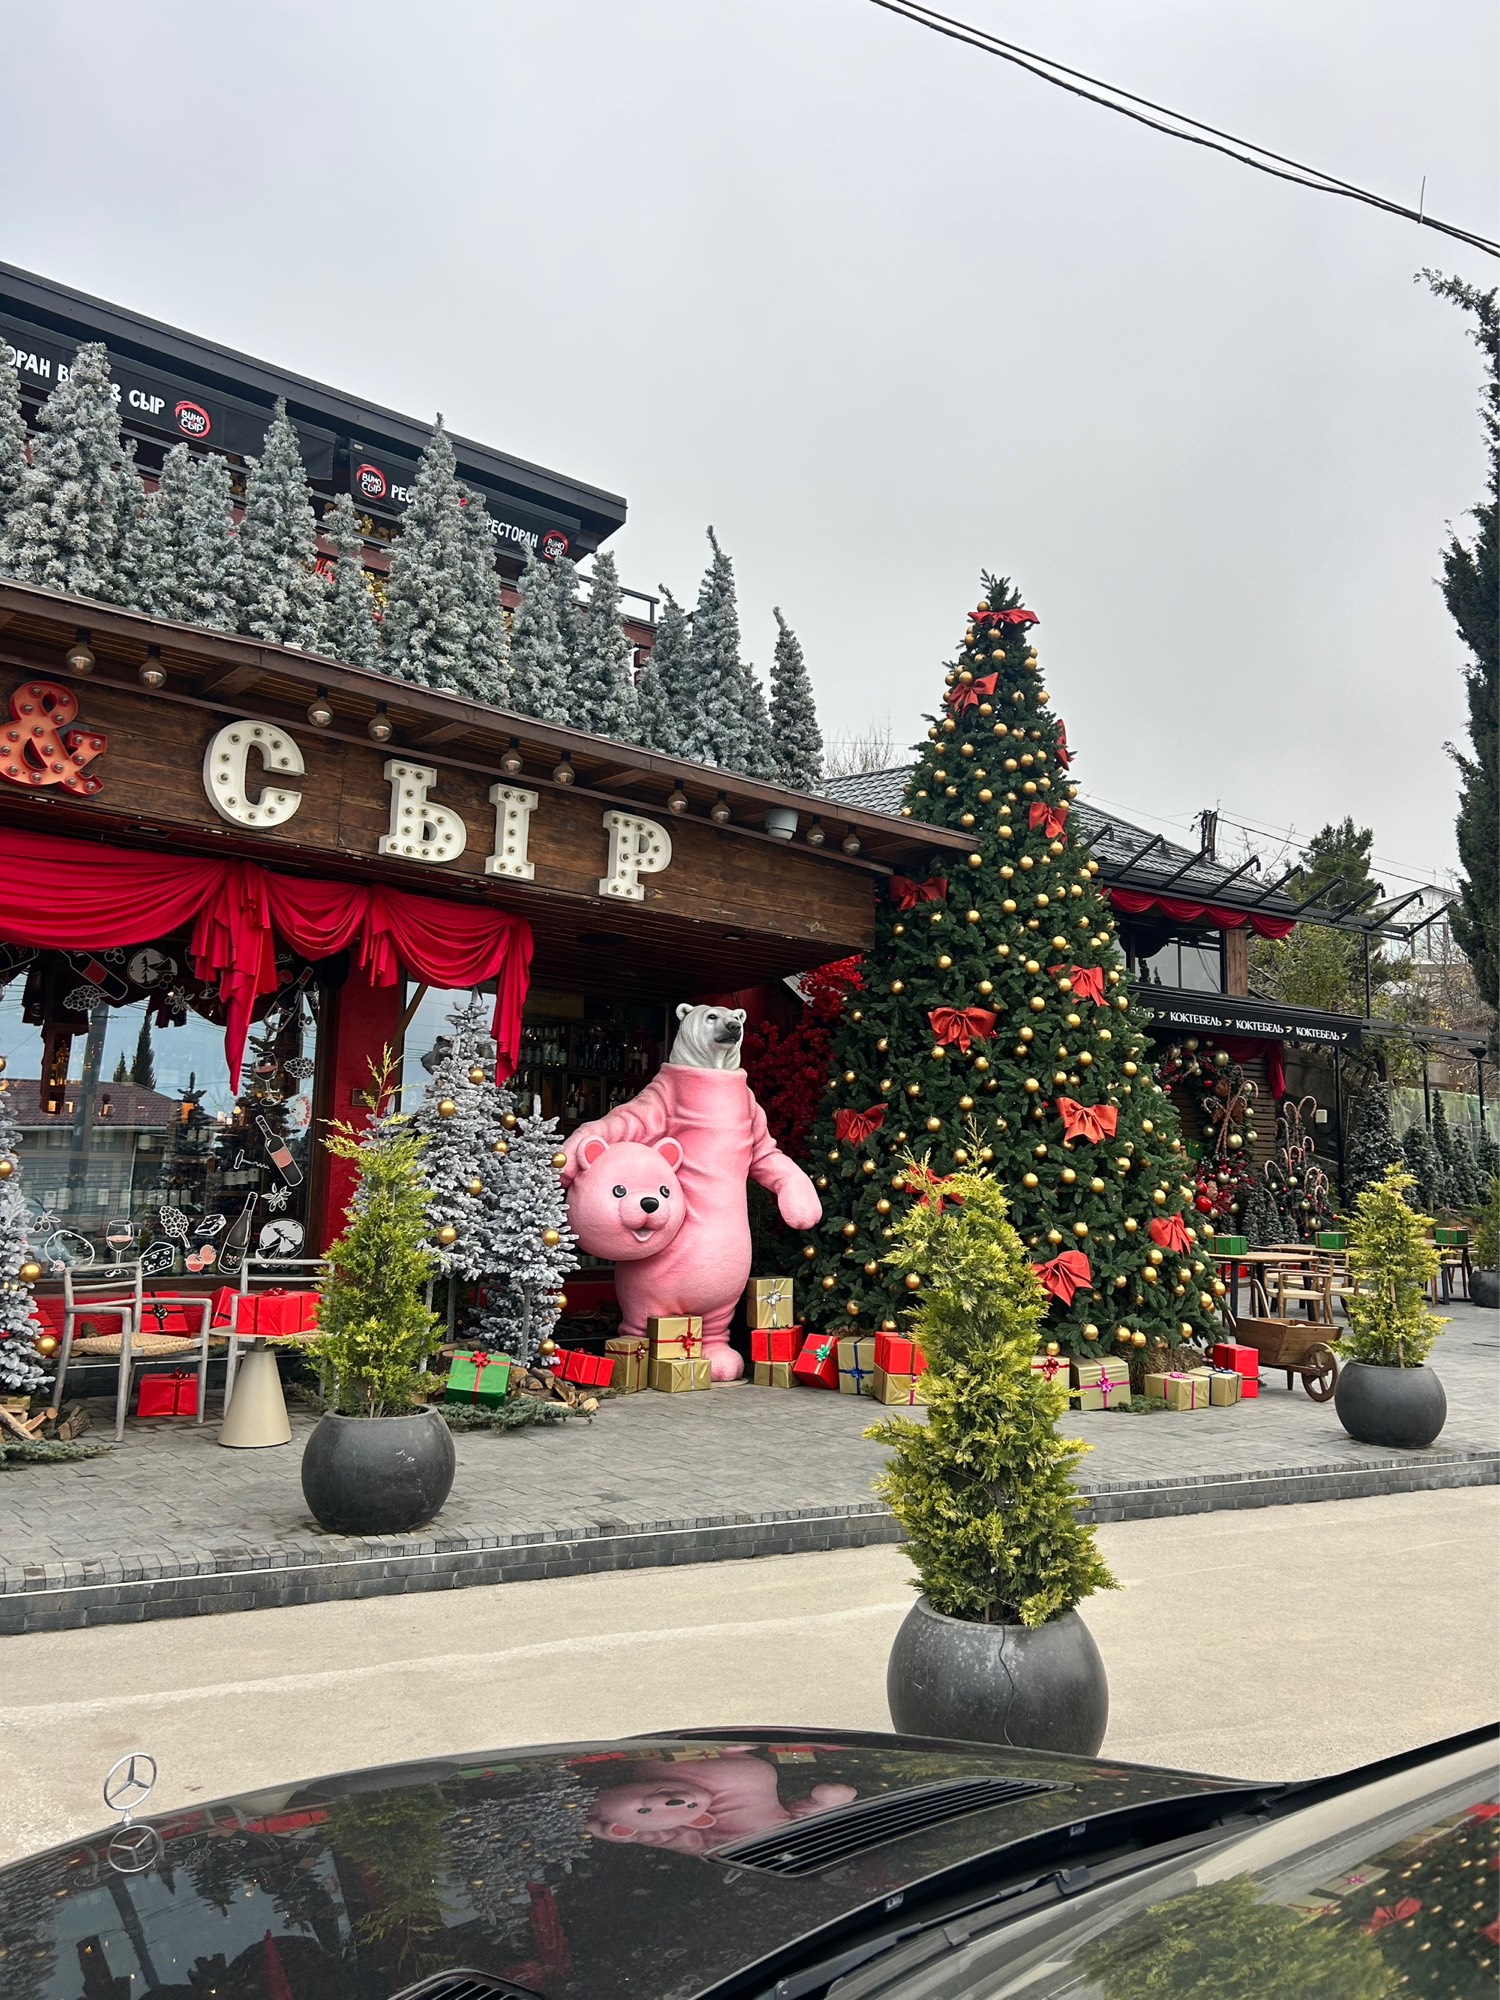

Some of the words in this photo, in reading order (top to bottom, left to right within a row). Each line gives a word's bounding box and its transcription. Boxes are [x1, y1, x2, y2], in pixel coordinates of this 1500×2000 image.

[109, 383, 122, 402] &
[129, 389, 166, 415] СЫР
[390, 484, 413, 504] РЕС
[485, 517, 539, 548] РЕСТОРАН
[0, 680, 107, 797] &
[203, 719, 672, 900] СЫР
[1170, 1011, 1222, 1027] КОКТЕБЕЛЬ
[1236, 1019, 1284, 1034] КОКТЕБЕЛЬ
[1296, 1026, 1340, 1041] КОКТЕБЕЛЬ
